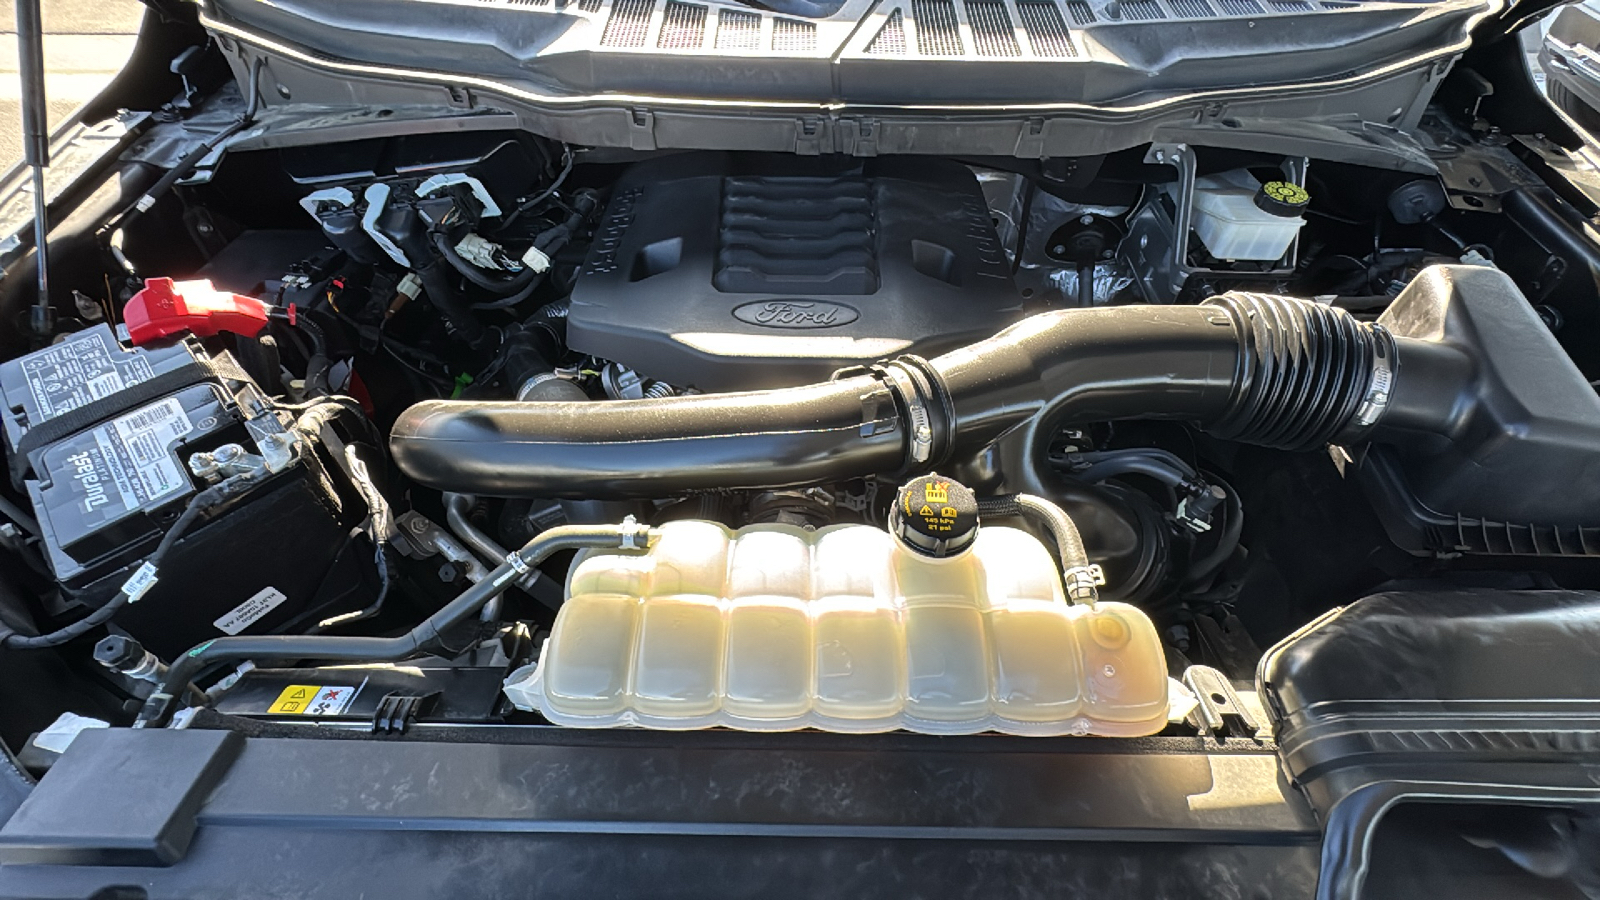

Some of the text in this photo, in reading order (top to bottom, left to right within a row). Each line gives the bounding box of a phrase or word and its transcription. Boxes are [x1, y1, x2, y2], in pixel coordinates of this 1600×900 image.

[755, 302, 838, 324] Ford
[89, 448, 110, 480] PLATINUM
[66, 451, 109, 512] Duralast
